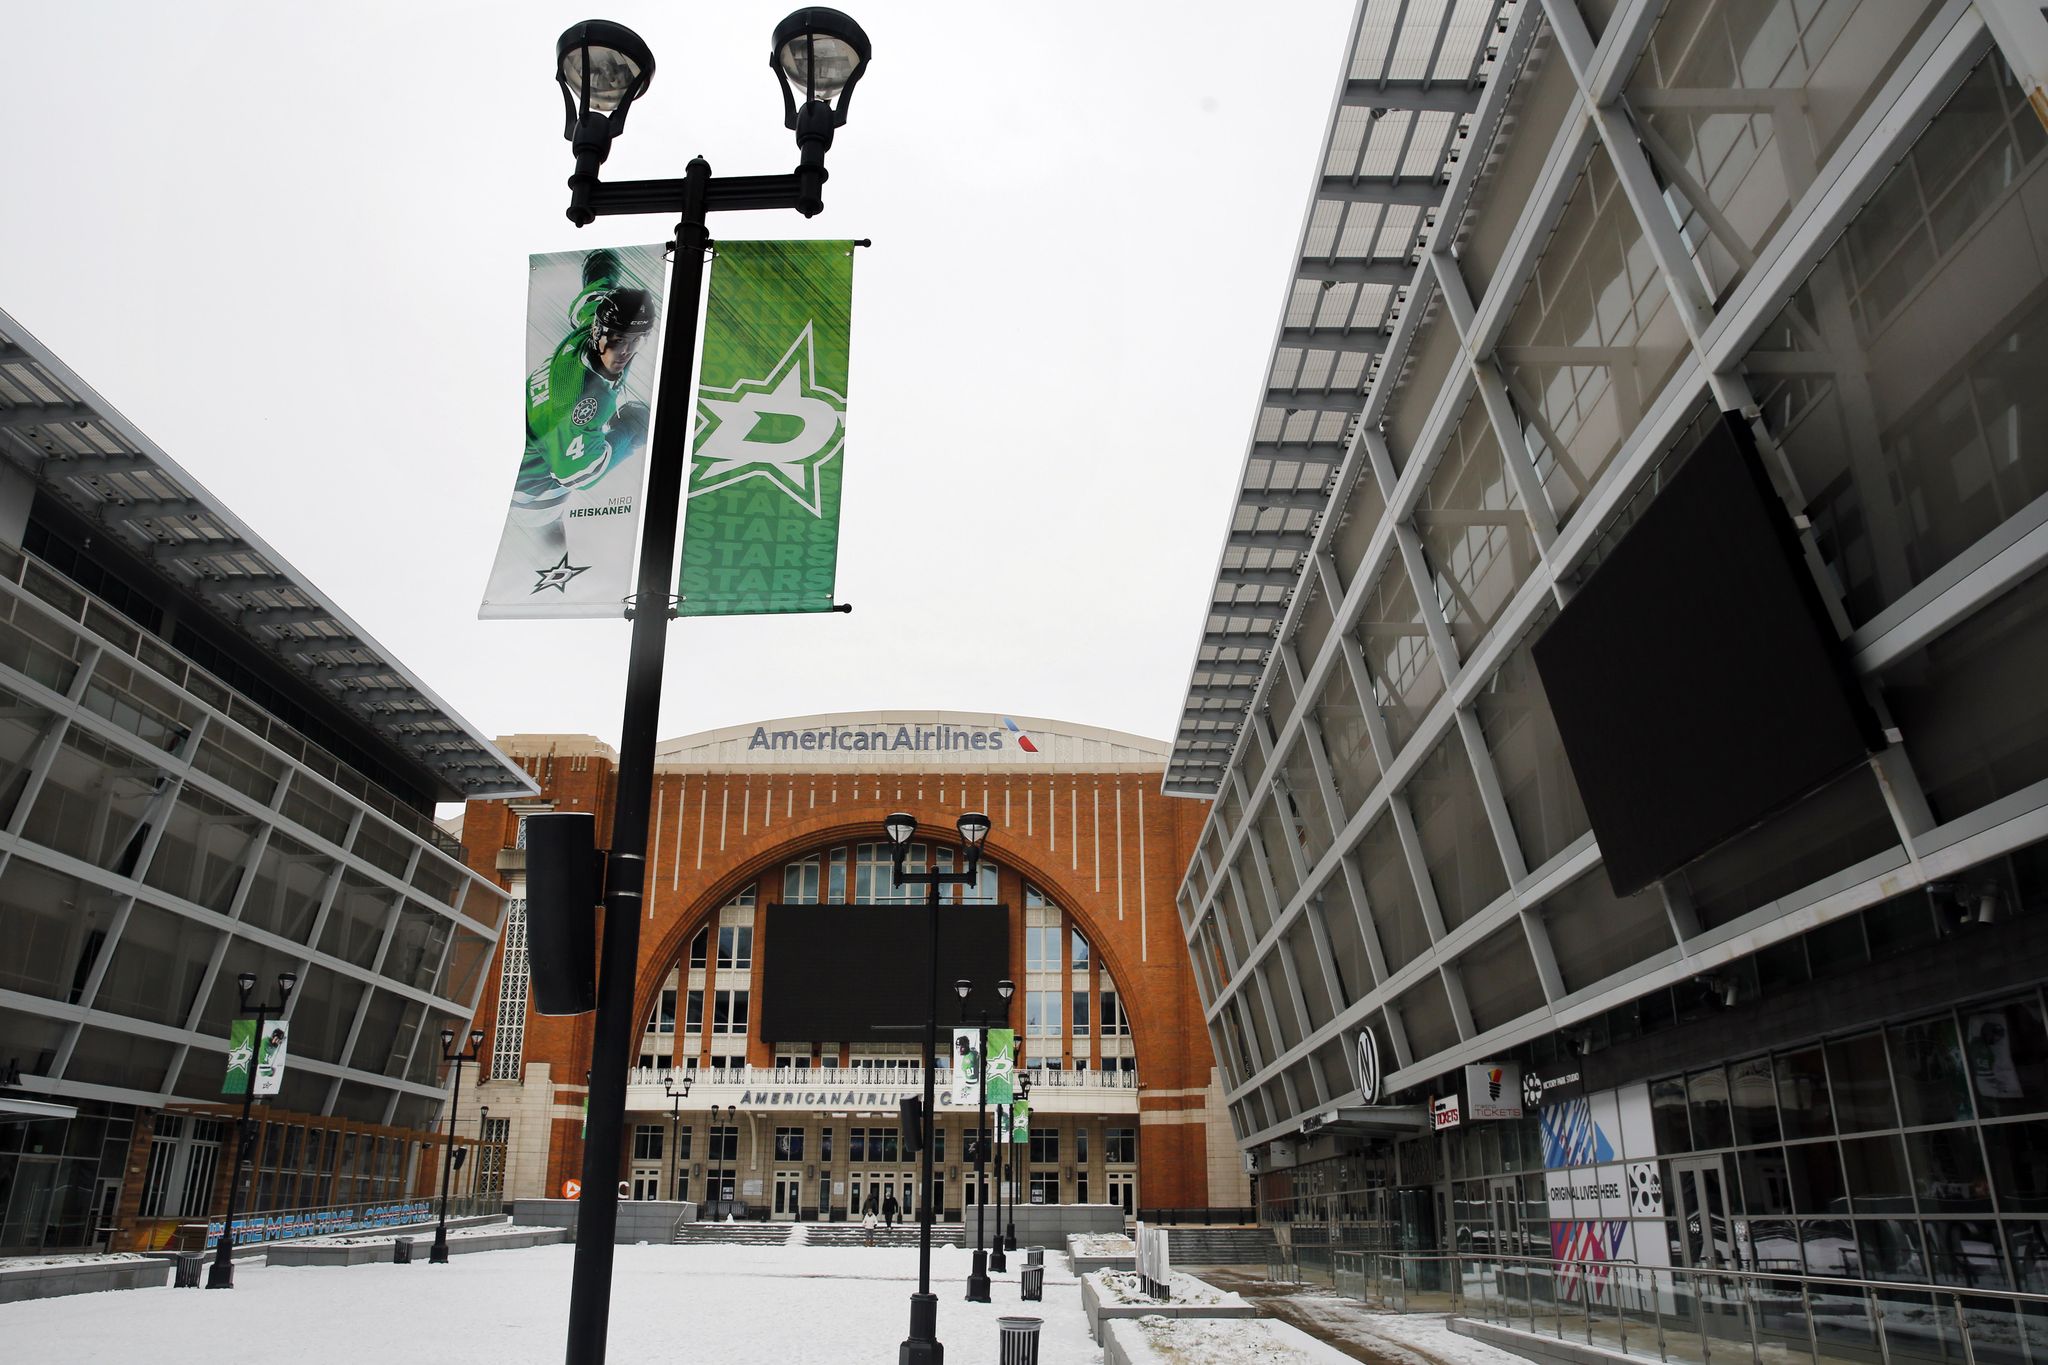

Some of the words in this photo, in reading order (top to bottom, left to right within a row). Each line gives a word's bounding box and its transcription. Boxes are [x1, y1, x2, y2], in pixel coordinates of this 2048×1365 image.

[565, 434, 585, 461] 4
[569, 505, 632, 518] HEISKANEN
[608, 496, 633, 506] MIRO
[687, 513, 836, 543] STARS
[685, 539, 834, 567] STARS
[682, 566, 832, 592] STARS
[740, 1090, 906, 1105] AMERICANAIRLI
[1436, 1108, 1459, 1125] TICKETS
[1550, 1185, 1580, 1201] ORIGINAL
[1580, 1185, 1599, 1200] LIVES
[1600, 1183, 1621, 1199] HERE.
[231, 1218, 265, 1244] THE
